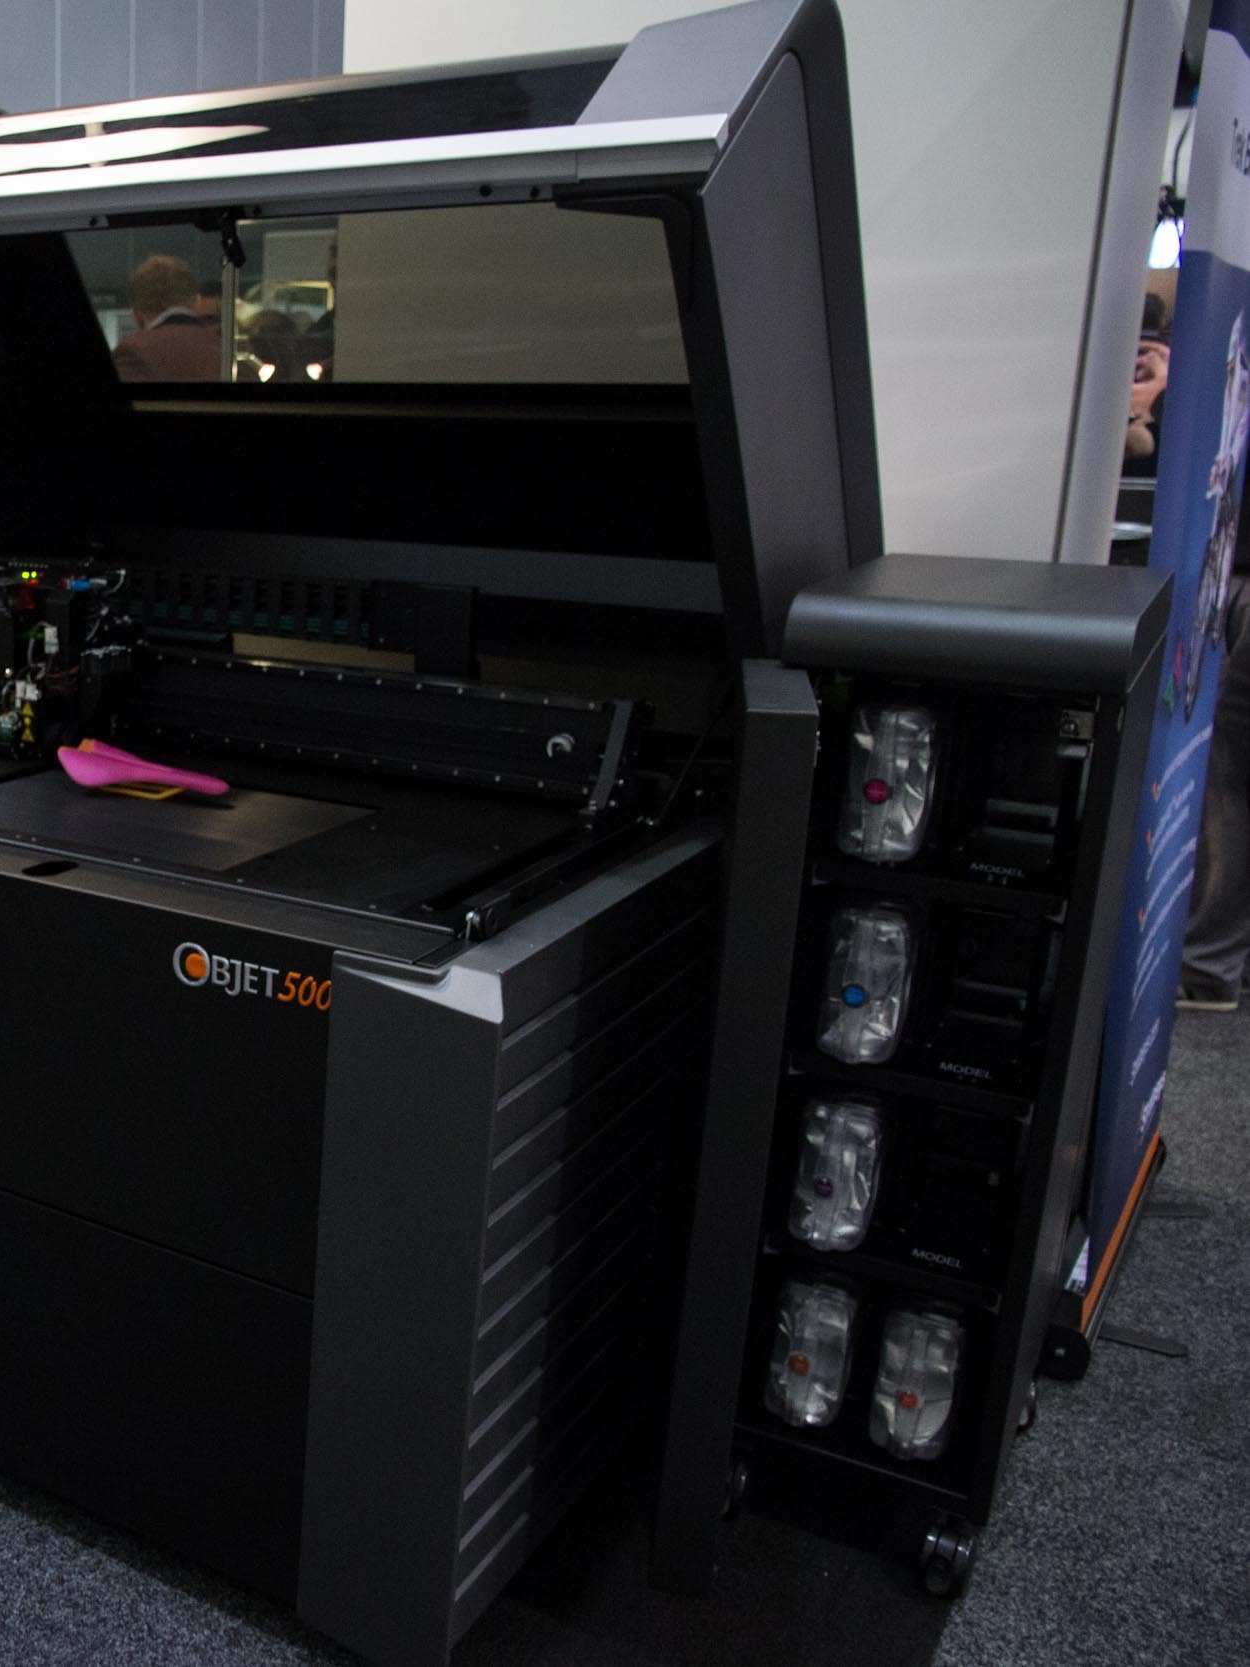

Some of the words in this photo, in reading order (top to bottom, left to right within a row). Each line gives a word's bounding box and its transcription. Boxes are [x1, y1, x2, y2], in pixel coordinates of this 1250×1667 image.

[969, 861, 1025, 879] MODEL
[939, 1061, 992, 1079] MODEL
[911, 1247, 963, 1269] MODEL
